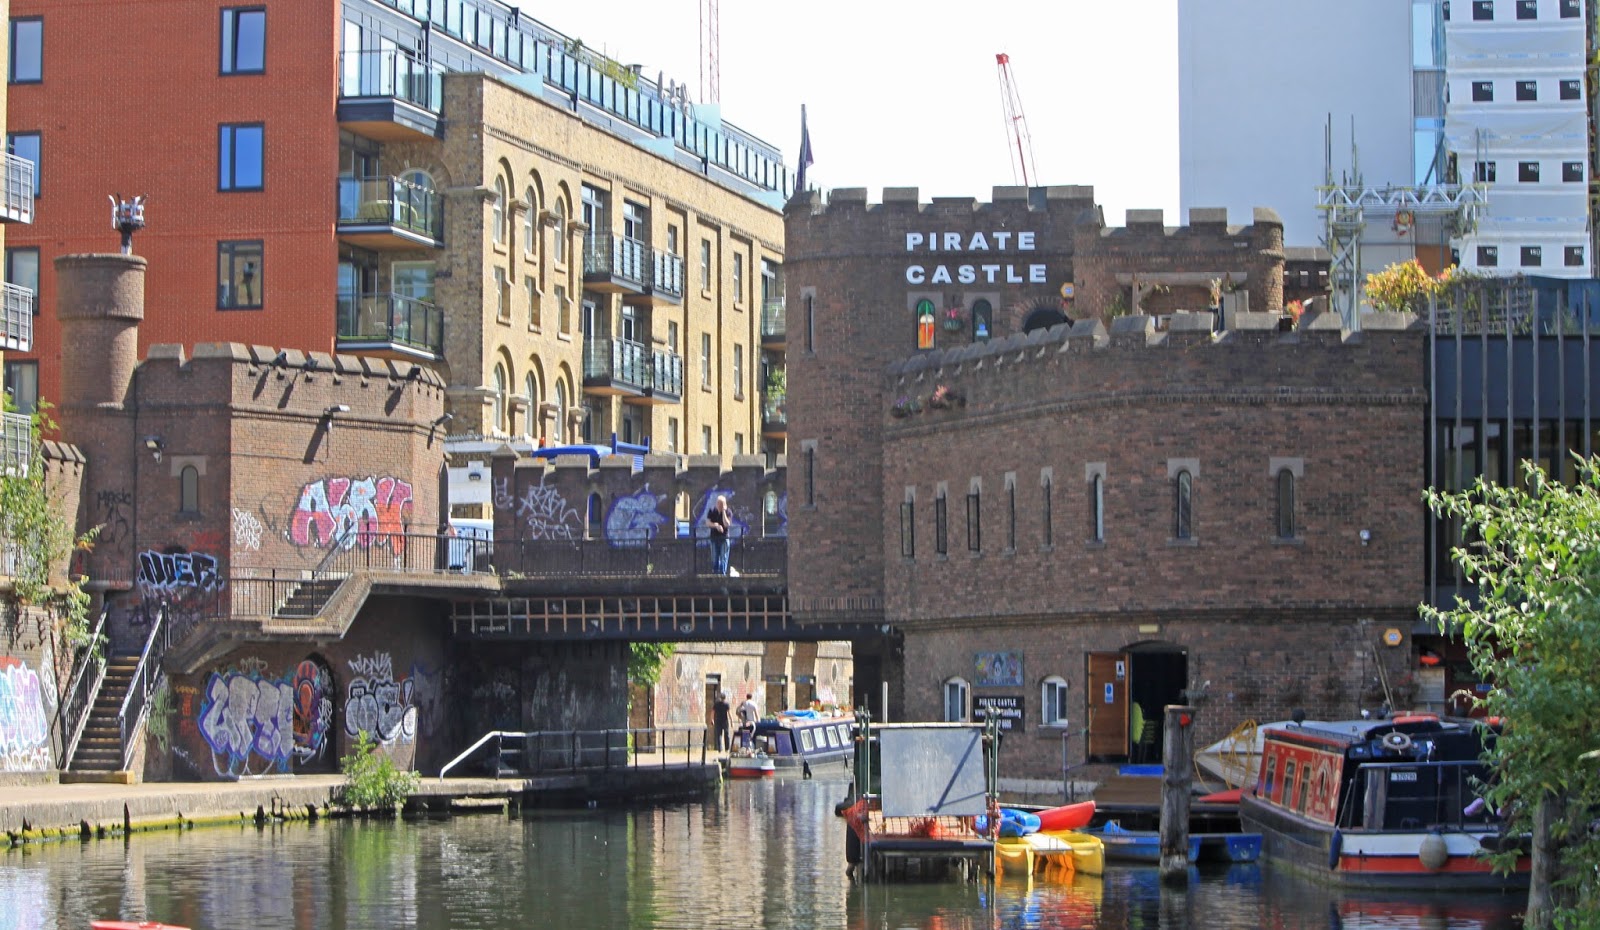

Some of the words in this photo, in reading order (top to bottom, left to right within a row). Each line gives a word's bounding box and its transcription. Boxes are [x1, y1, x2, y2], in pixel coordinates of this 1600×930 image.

[906, 231, 1036, 251] PIRATE
[906, 264, 1047, 284] CASTLE
[997, 698, 1017, 707] CASTLE
